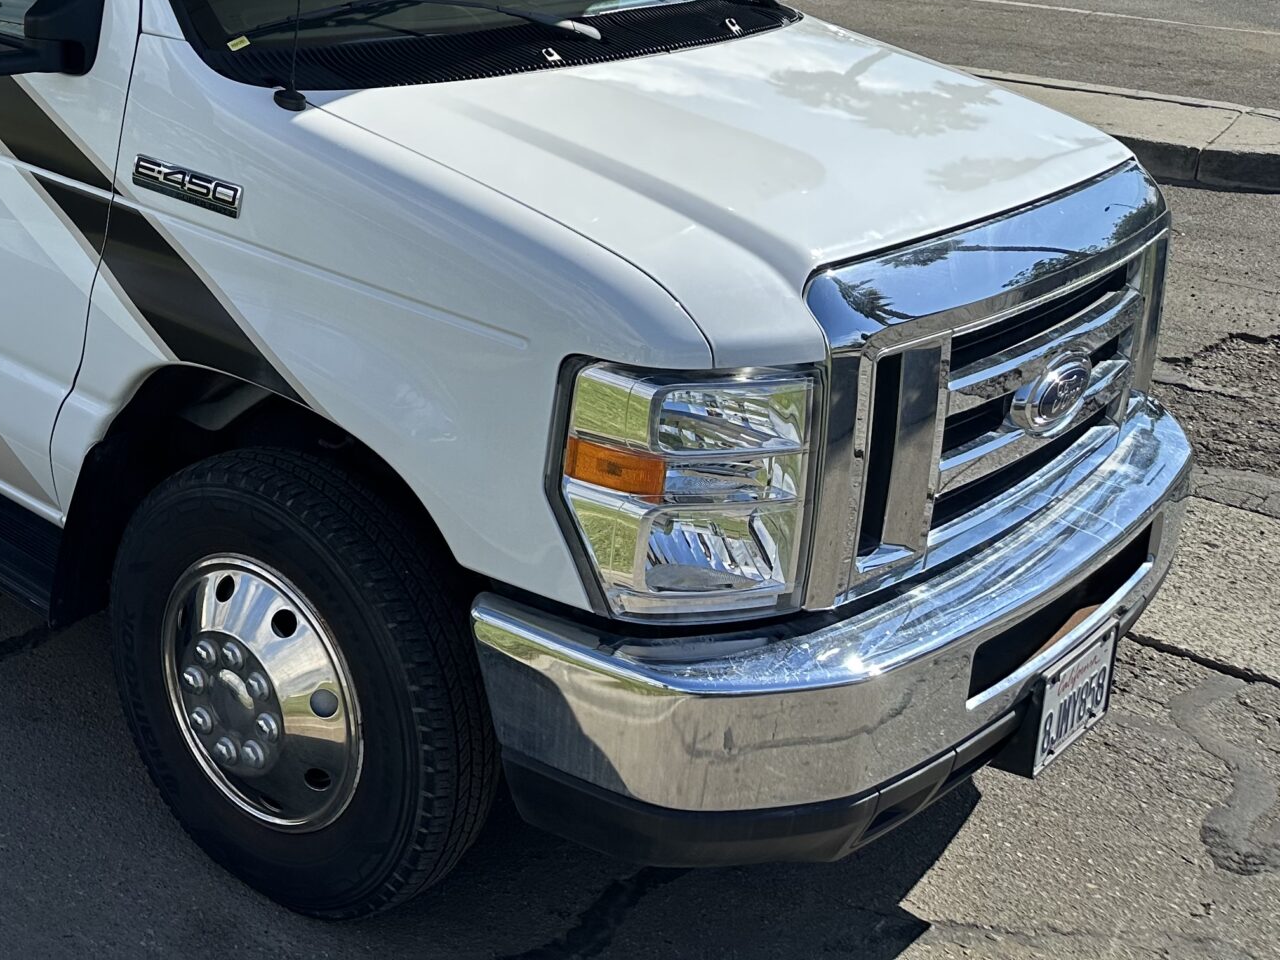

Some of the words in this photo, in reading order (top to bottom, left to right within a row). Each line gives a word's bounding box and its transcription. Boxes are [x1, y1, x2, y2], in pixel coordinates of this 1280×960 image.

[134, 156, 239, 207] E-450
[1051, 375, 1084, 414] Ford
[1056, 654, 1101, 696] California
[1041, 665, 1107, 755] 8JMY858
